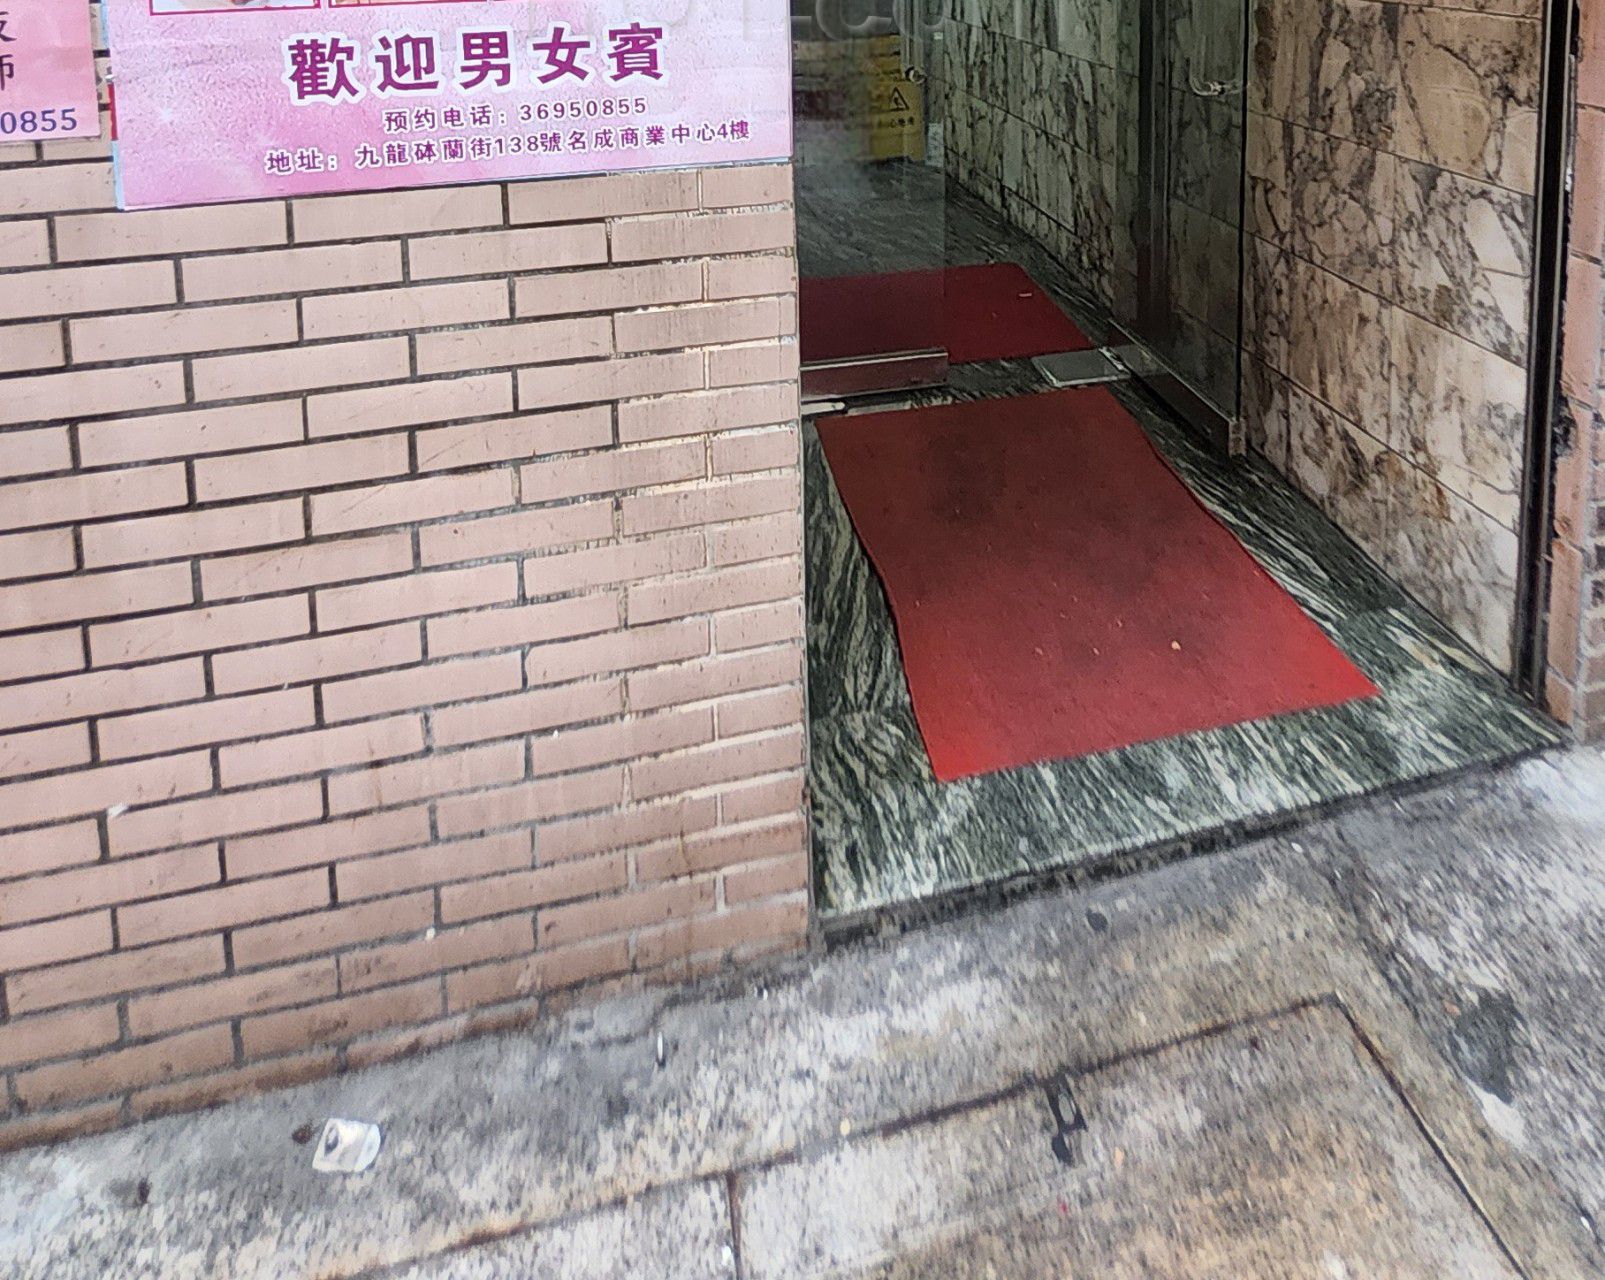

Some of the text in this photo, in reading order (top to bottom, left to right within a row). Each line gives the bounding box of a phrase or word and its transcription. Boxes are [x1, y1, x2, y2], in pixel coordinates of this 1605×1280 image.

[288, 22, 664, 100] 歡迎男女賓
